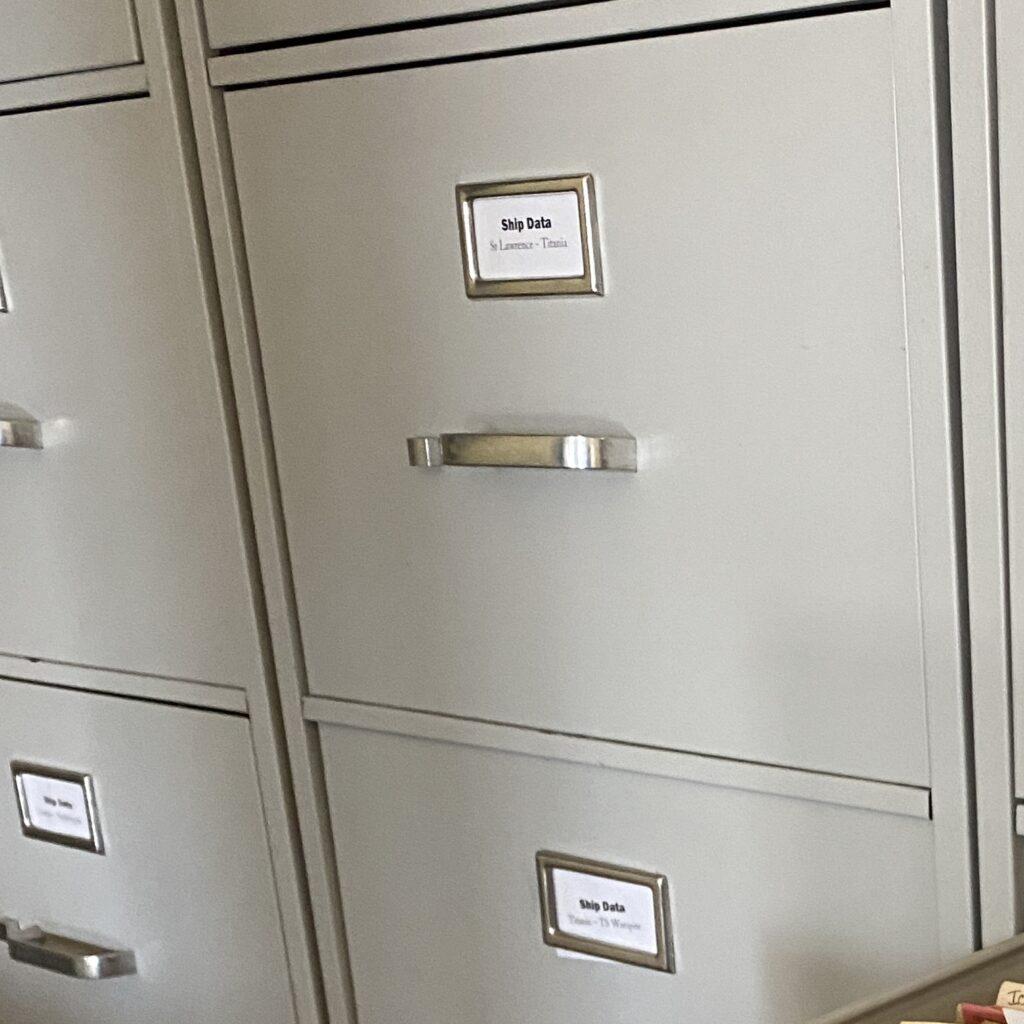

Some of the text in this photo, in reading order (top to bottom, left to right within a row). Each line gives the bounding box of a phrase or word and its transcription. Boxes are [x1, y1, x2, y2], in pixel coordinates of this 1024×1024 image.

[501, 217, 552, 232] Ship Data
[579, 899, 626, 913] Ship Data
